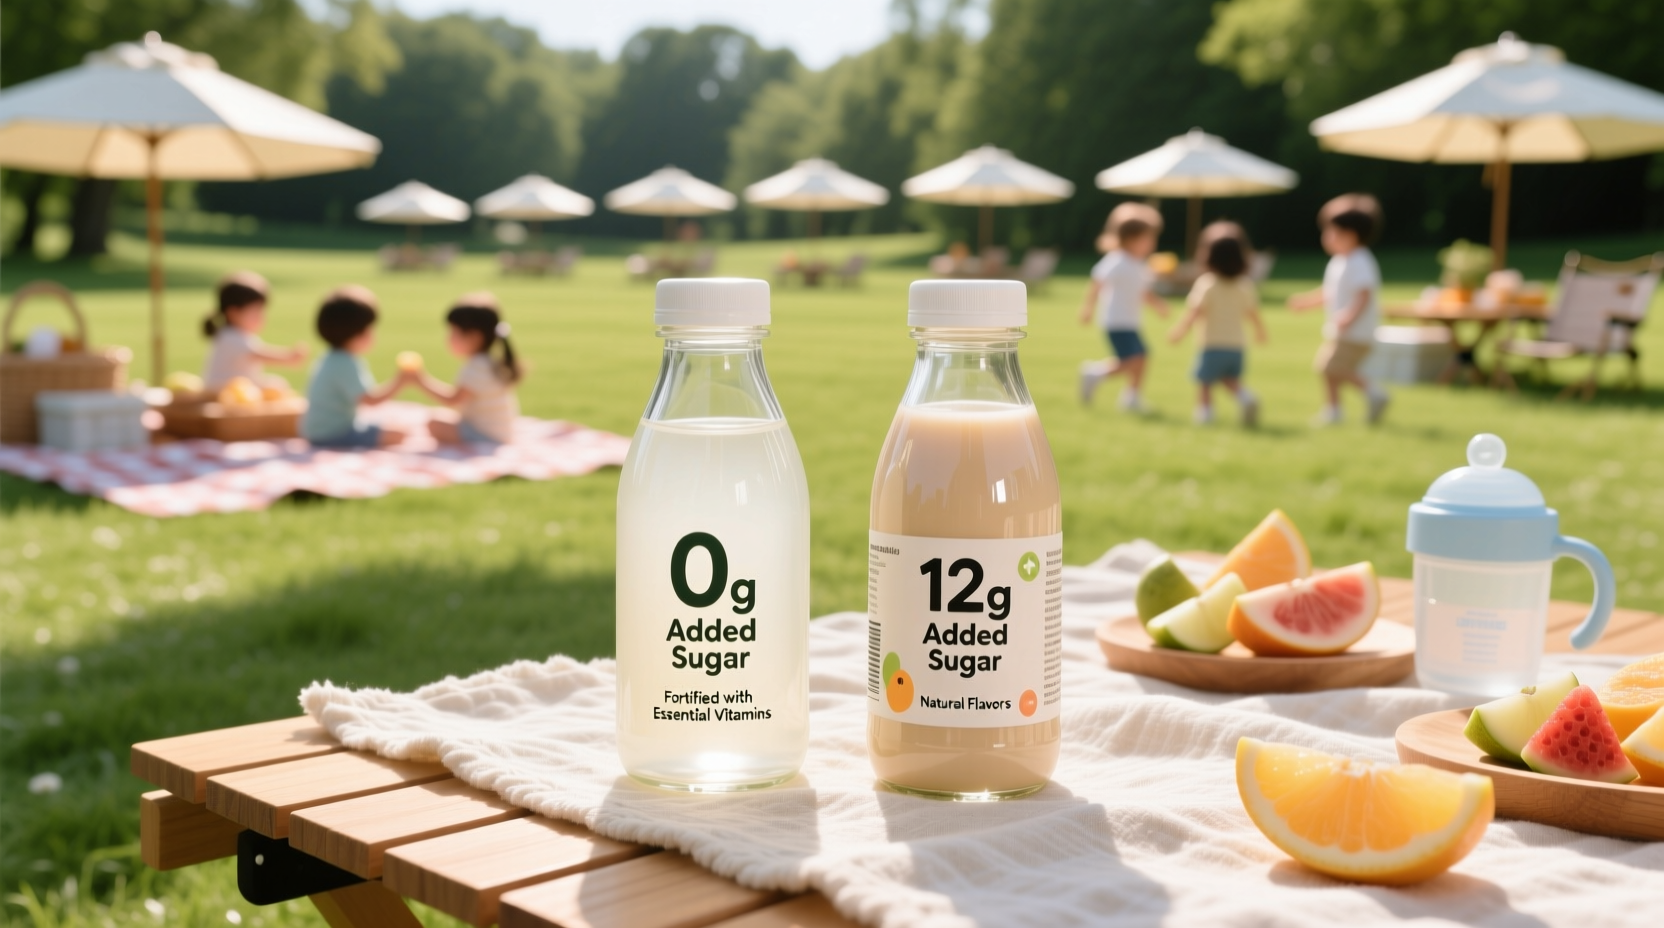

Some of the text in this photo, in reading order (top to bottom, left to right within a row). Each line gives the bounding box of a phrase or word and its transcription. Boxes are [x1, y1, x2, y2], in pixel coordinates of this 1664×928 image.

[671, 532, 755, 614] 0g
[920, 558, 1011, 620] 12g
[666, 618, 755, 642] Added
[923, 623, 1007, 645] Added
[672, 645, 750, 676] Sugar
[929, 649, 1001, 678] Sugar
[664, 691, 752, 704] Fortified with
[921, 696, 1011, 710] Natural Flavors
[654, 708, 771, 721] Essential Vitamins
